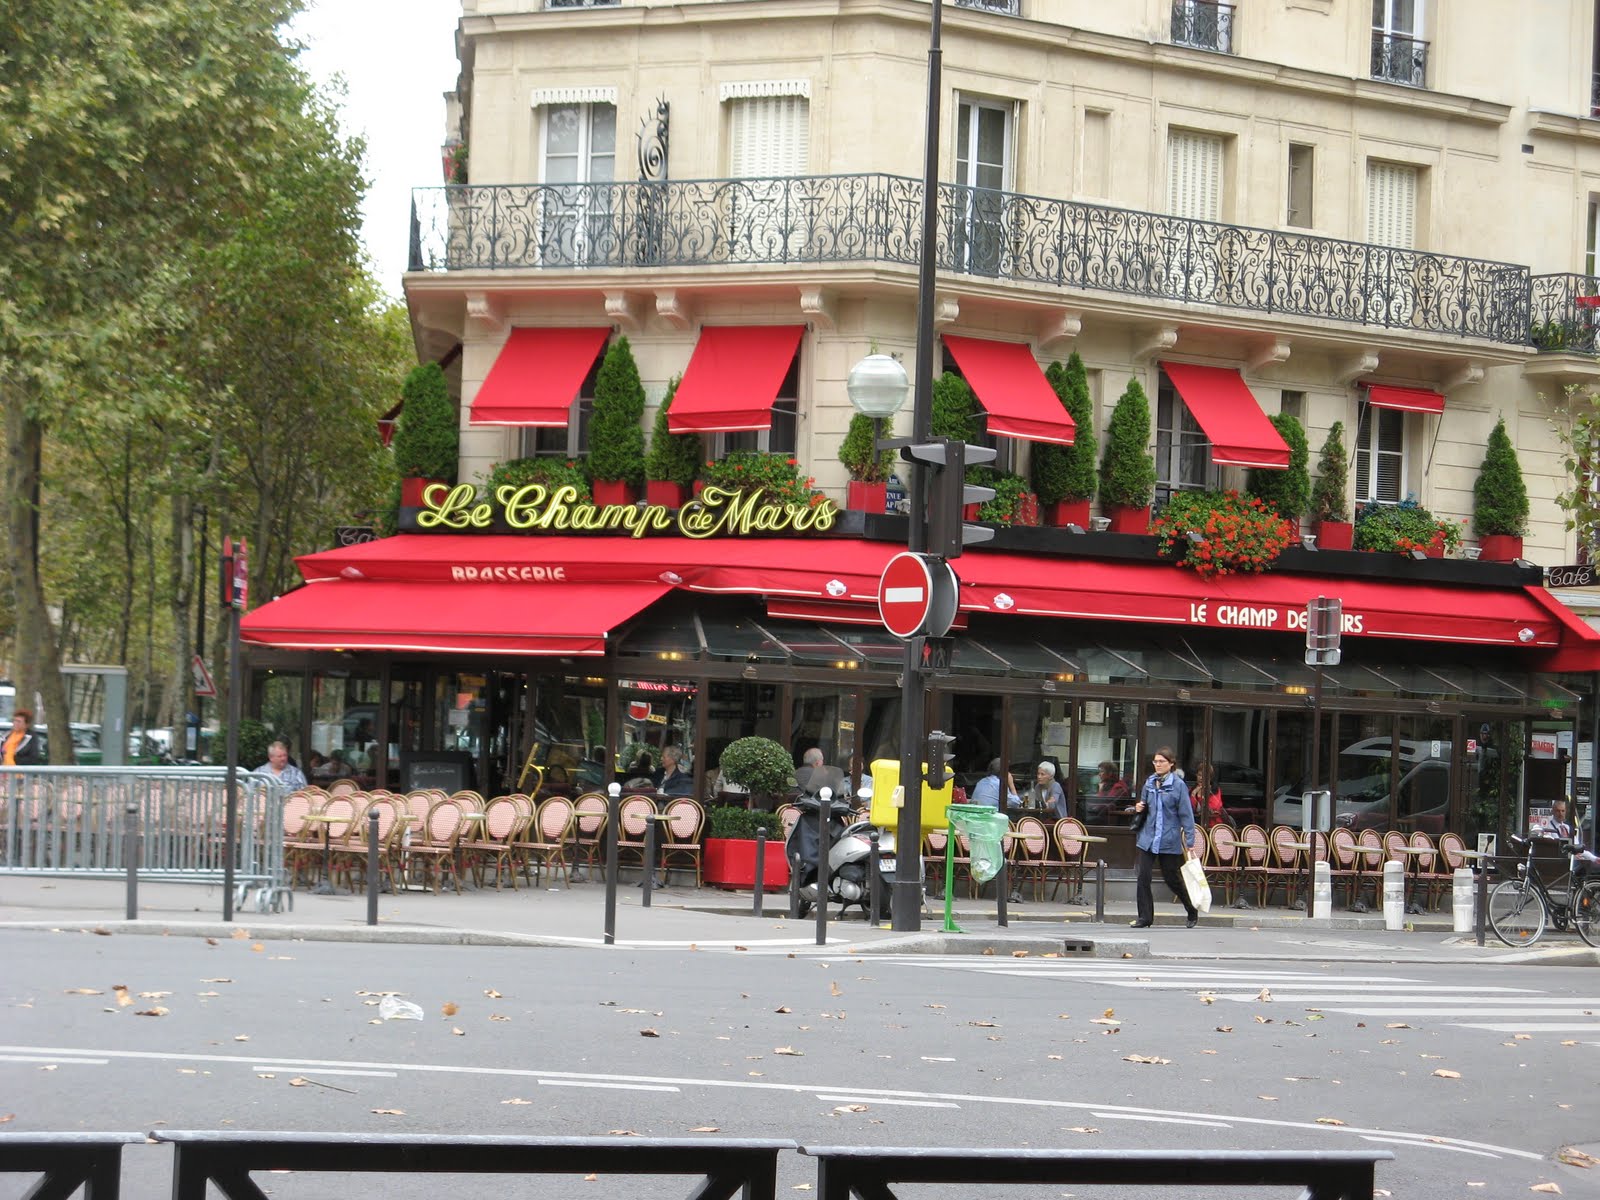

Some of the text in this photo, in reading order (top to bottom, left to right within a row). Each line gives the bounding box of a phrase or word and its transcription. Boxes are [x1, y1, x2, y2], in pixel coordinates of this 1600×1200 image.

[416, 483, 838, 538] Le Champ de Mars
[451, 566, 566, 581] BRASSERIE
[1550, 566, 1592, 586] Café
[1190, 603, 1363, 634] LE CHAMP DE RS
